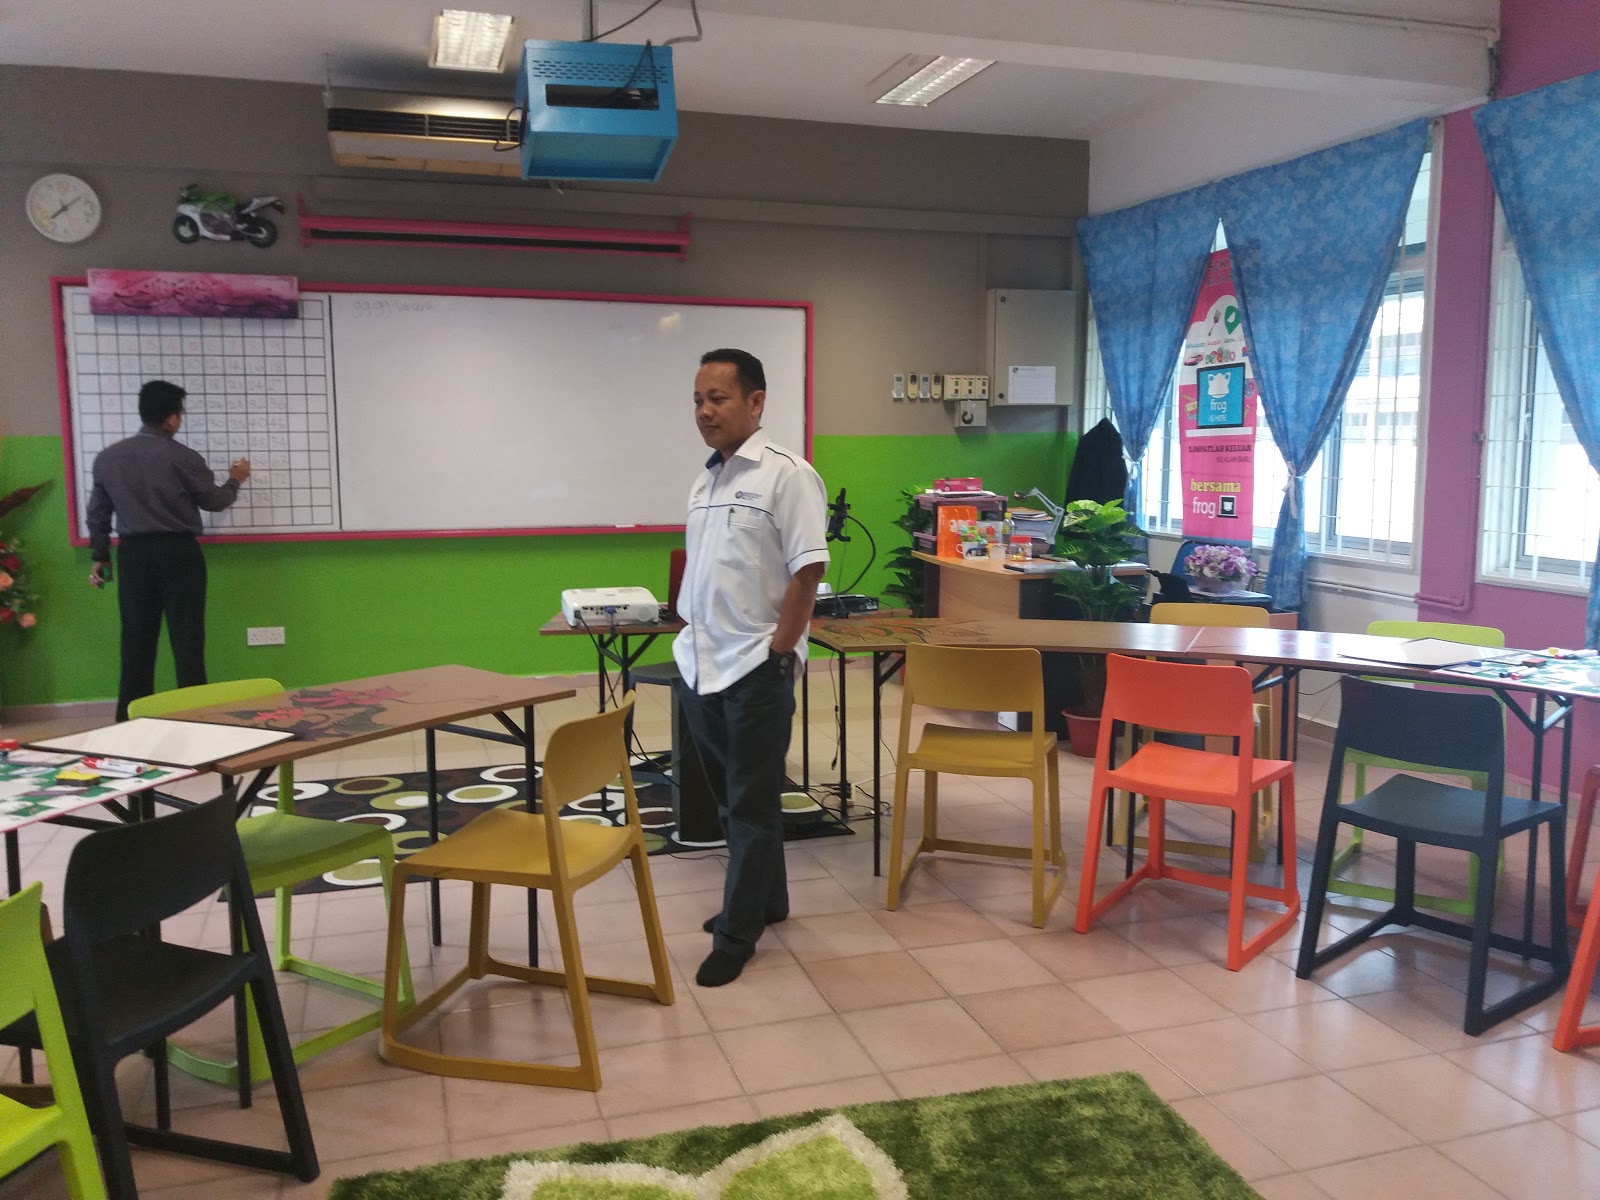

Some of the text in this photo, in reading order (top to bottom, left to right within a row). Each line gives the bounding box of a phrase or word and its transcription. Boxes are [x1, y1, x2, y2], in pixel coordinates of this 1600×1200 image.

[1210, 398, 1227, 413] frog
[1190, 477, 1241, 493] bersama
[1192, 496, 1216, 519] frog
